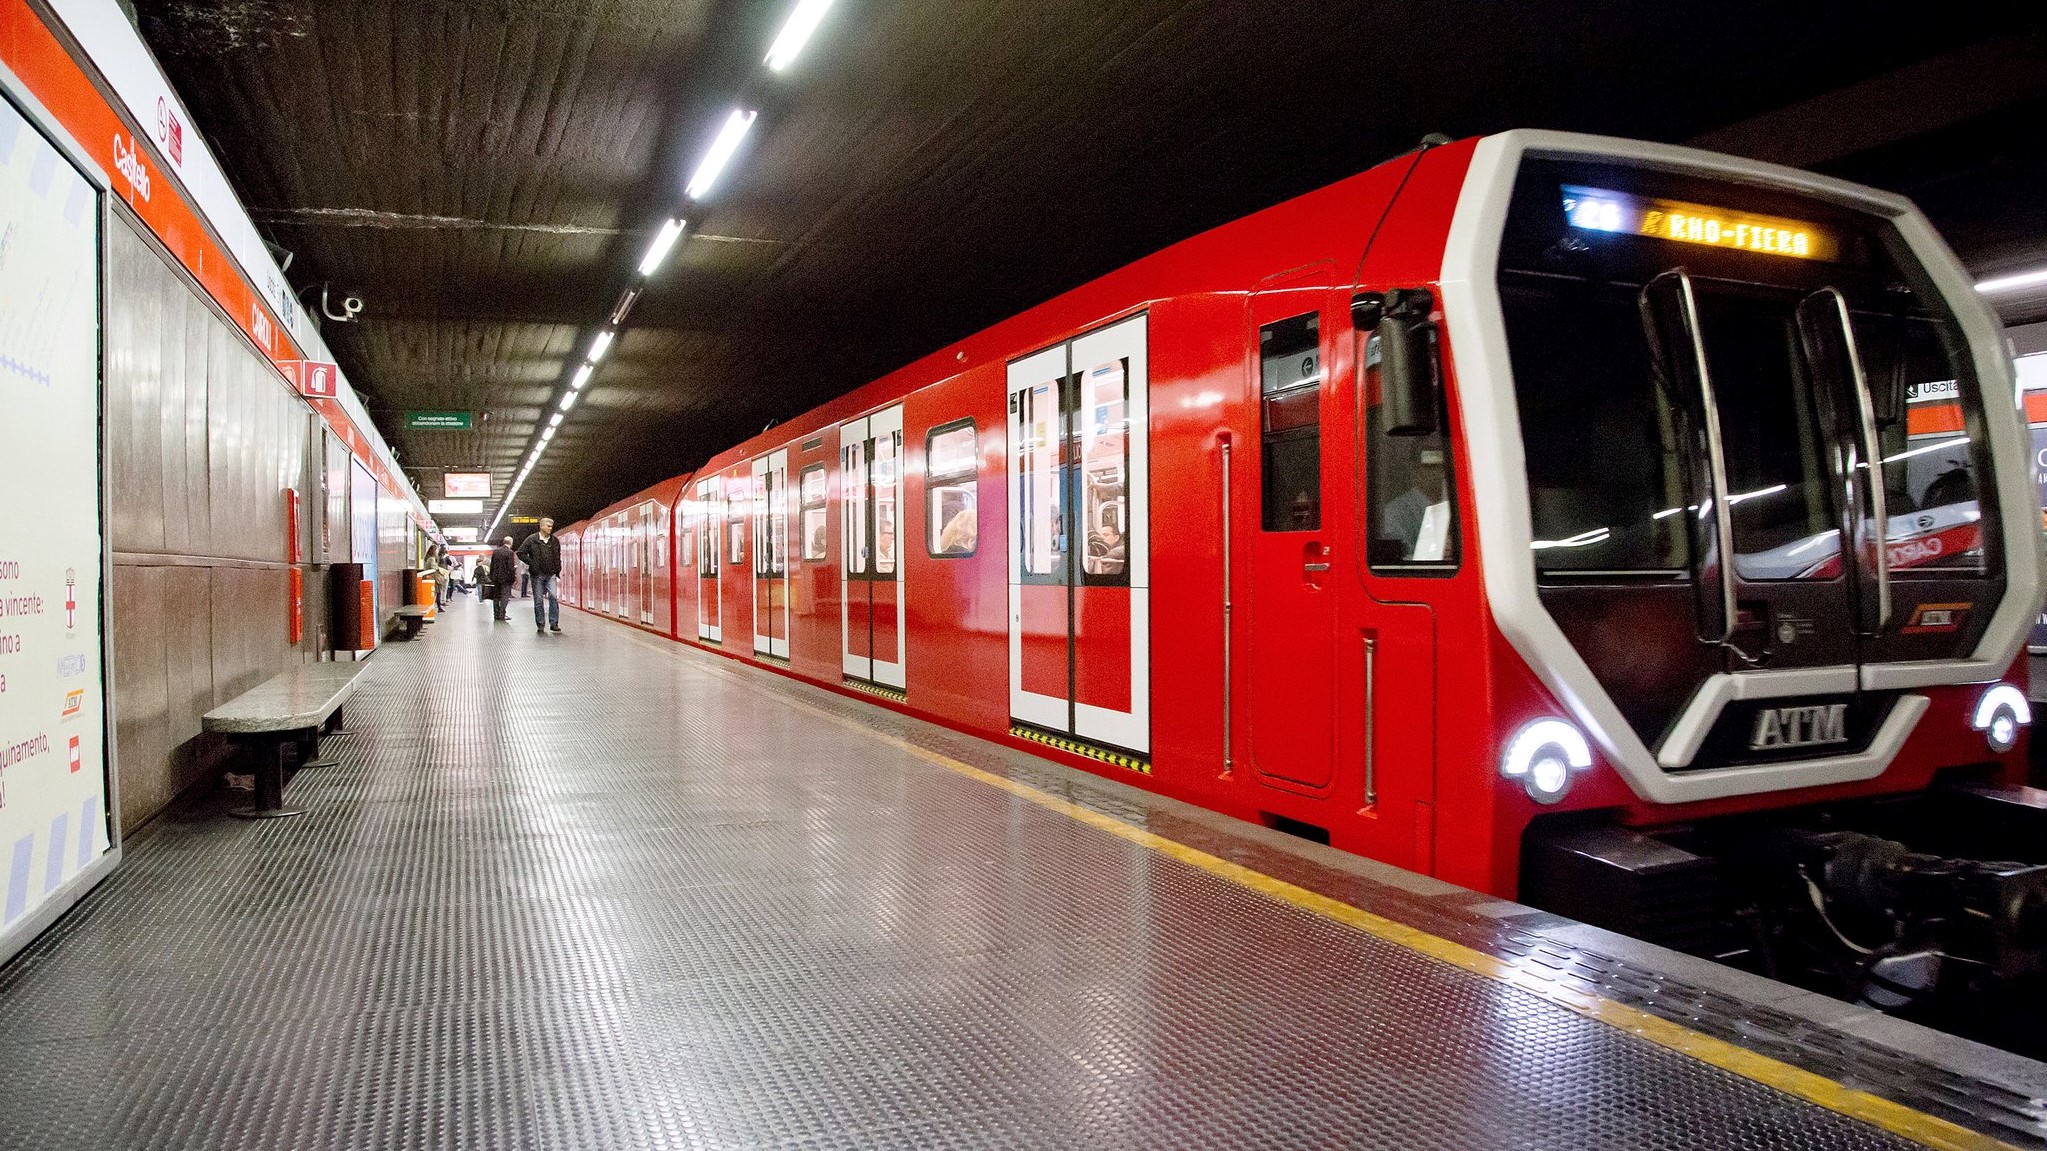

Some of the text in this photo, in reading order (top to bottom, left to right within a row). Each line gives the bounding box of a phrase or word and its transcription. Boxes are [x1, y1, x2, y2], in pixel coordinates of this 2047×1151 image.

[113, 132, 151, 204] Castello
[1668, 213, 1810, 256] RHO-FIERA
[5, 590, 44, 617] vincente:
[15, 633, 21, 653] a
[1750, 704, 1849, 750] ATM
